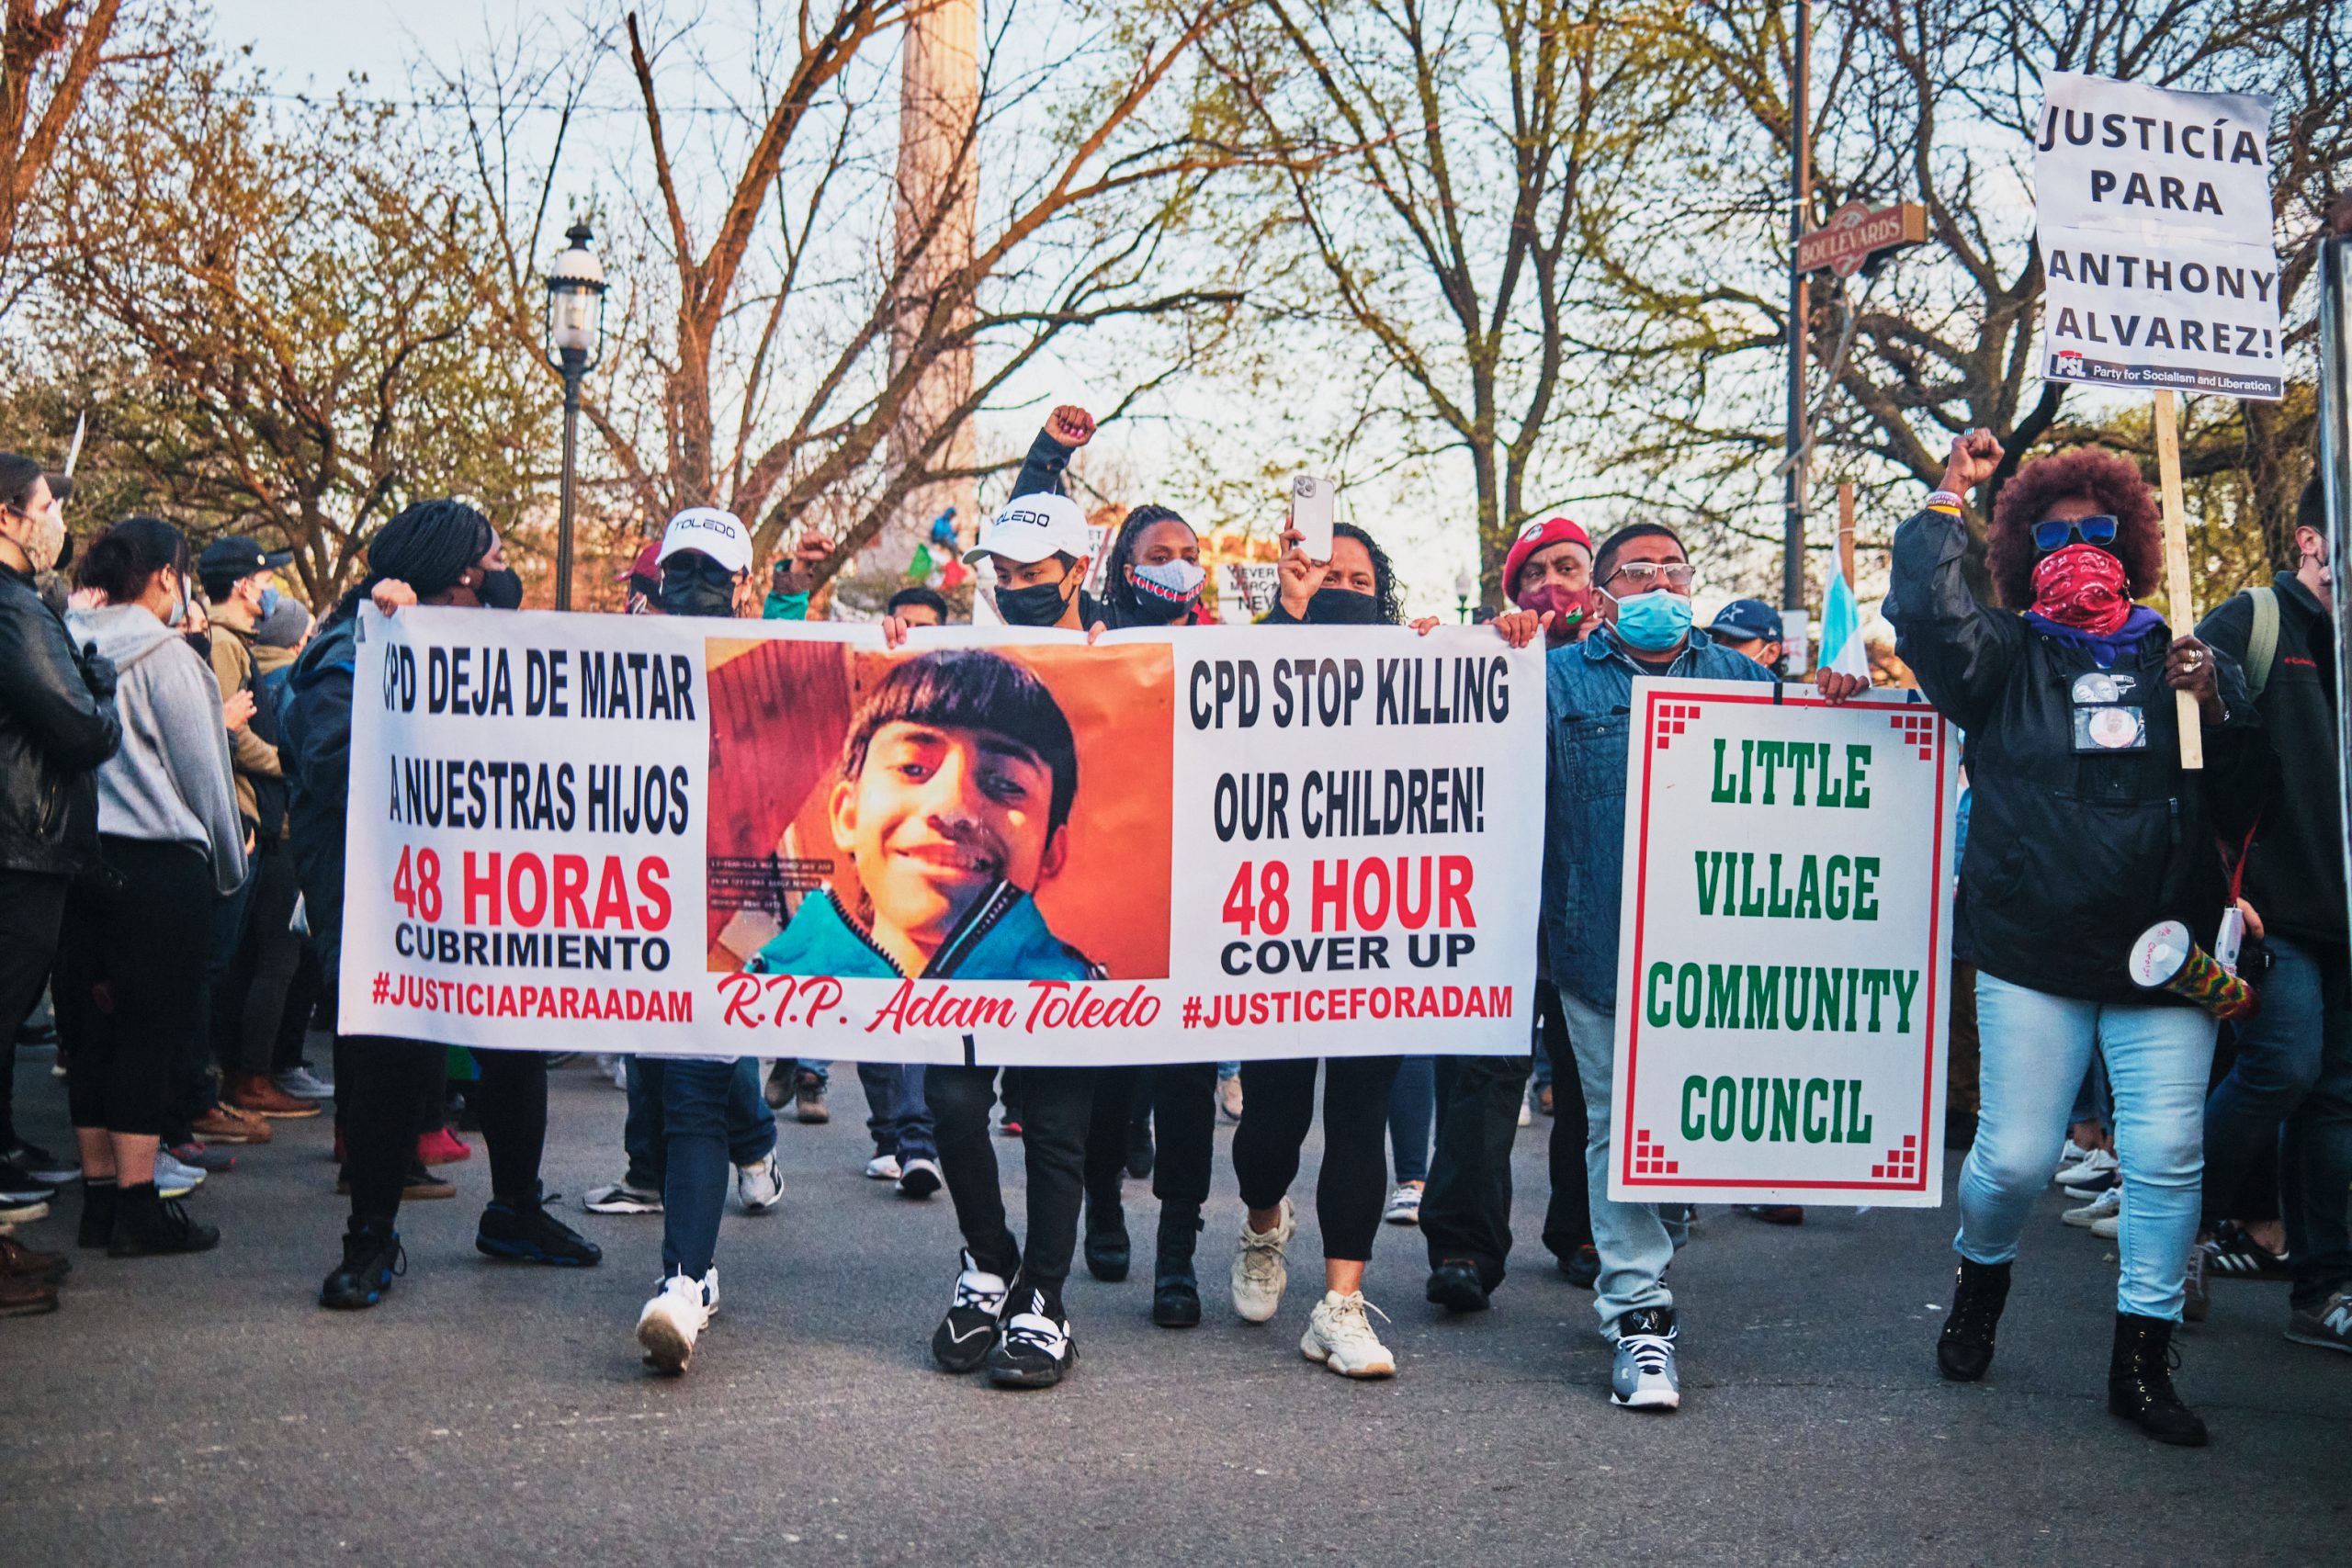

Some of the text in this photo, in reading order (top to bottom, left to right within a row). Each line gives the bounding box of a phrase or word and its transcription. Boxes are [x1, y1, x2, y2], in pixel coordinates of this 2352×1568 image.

[2038, 106, 2263, 166] JUSTICÍA
[2091, 169, 2223, 215] PARA
[1801, 216, 1900, 265] BOULEVARDS
[2049, 249, 2276, 302] ANTHONY
[2054, 307, 2274, 359] ALVAREZ!
[2055, 356, 2271, 392] PSL Party for Socialism and Liberation
[674, 518, 735, 539] TOLEDO
[996, 510, 1050, 528] OLEDO
[1136, 576, 1178, 603] GUCCI
[383, 641, 695, 721] CPD DEJA DE MATAR
[1190, 655, 1510, 729] CPD STOP KILLING
[390, 755, 689, 835] A NUESTRAS HIJOS
[1711, 739, 1871, 808] LITTLE
[1214, 766, 1485, 842] OUR CHILDREN!
[393, 844, 672, 931] 48 HORAS
[1222, 854, 1477, 936] 48 HOUR
[1694, 851, 1881, 921] VILLAGE
[395, 922, 671, 972] CUBRIMIENTO
[1220, 933, 1476, 976] COVER UP
[372, 971, 693, 1023] #JUSTICIAPARAADAM
[717, 973, 1161, 1035] R.I.P. Adam Toledo
[1182, 986, 1512, 1030] #JUSTICEFORADAM
[1646, 961, 1920, 1034] COMMUNITY
[1680, 1075, 1872, 1145] COUNCIL
